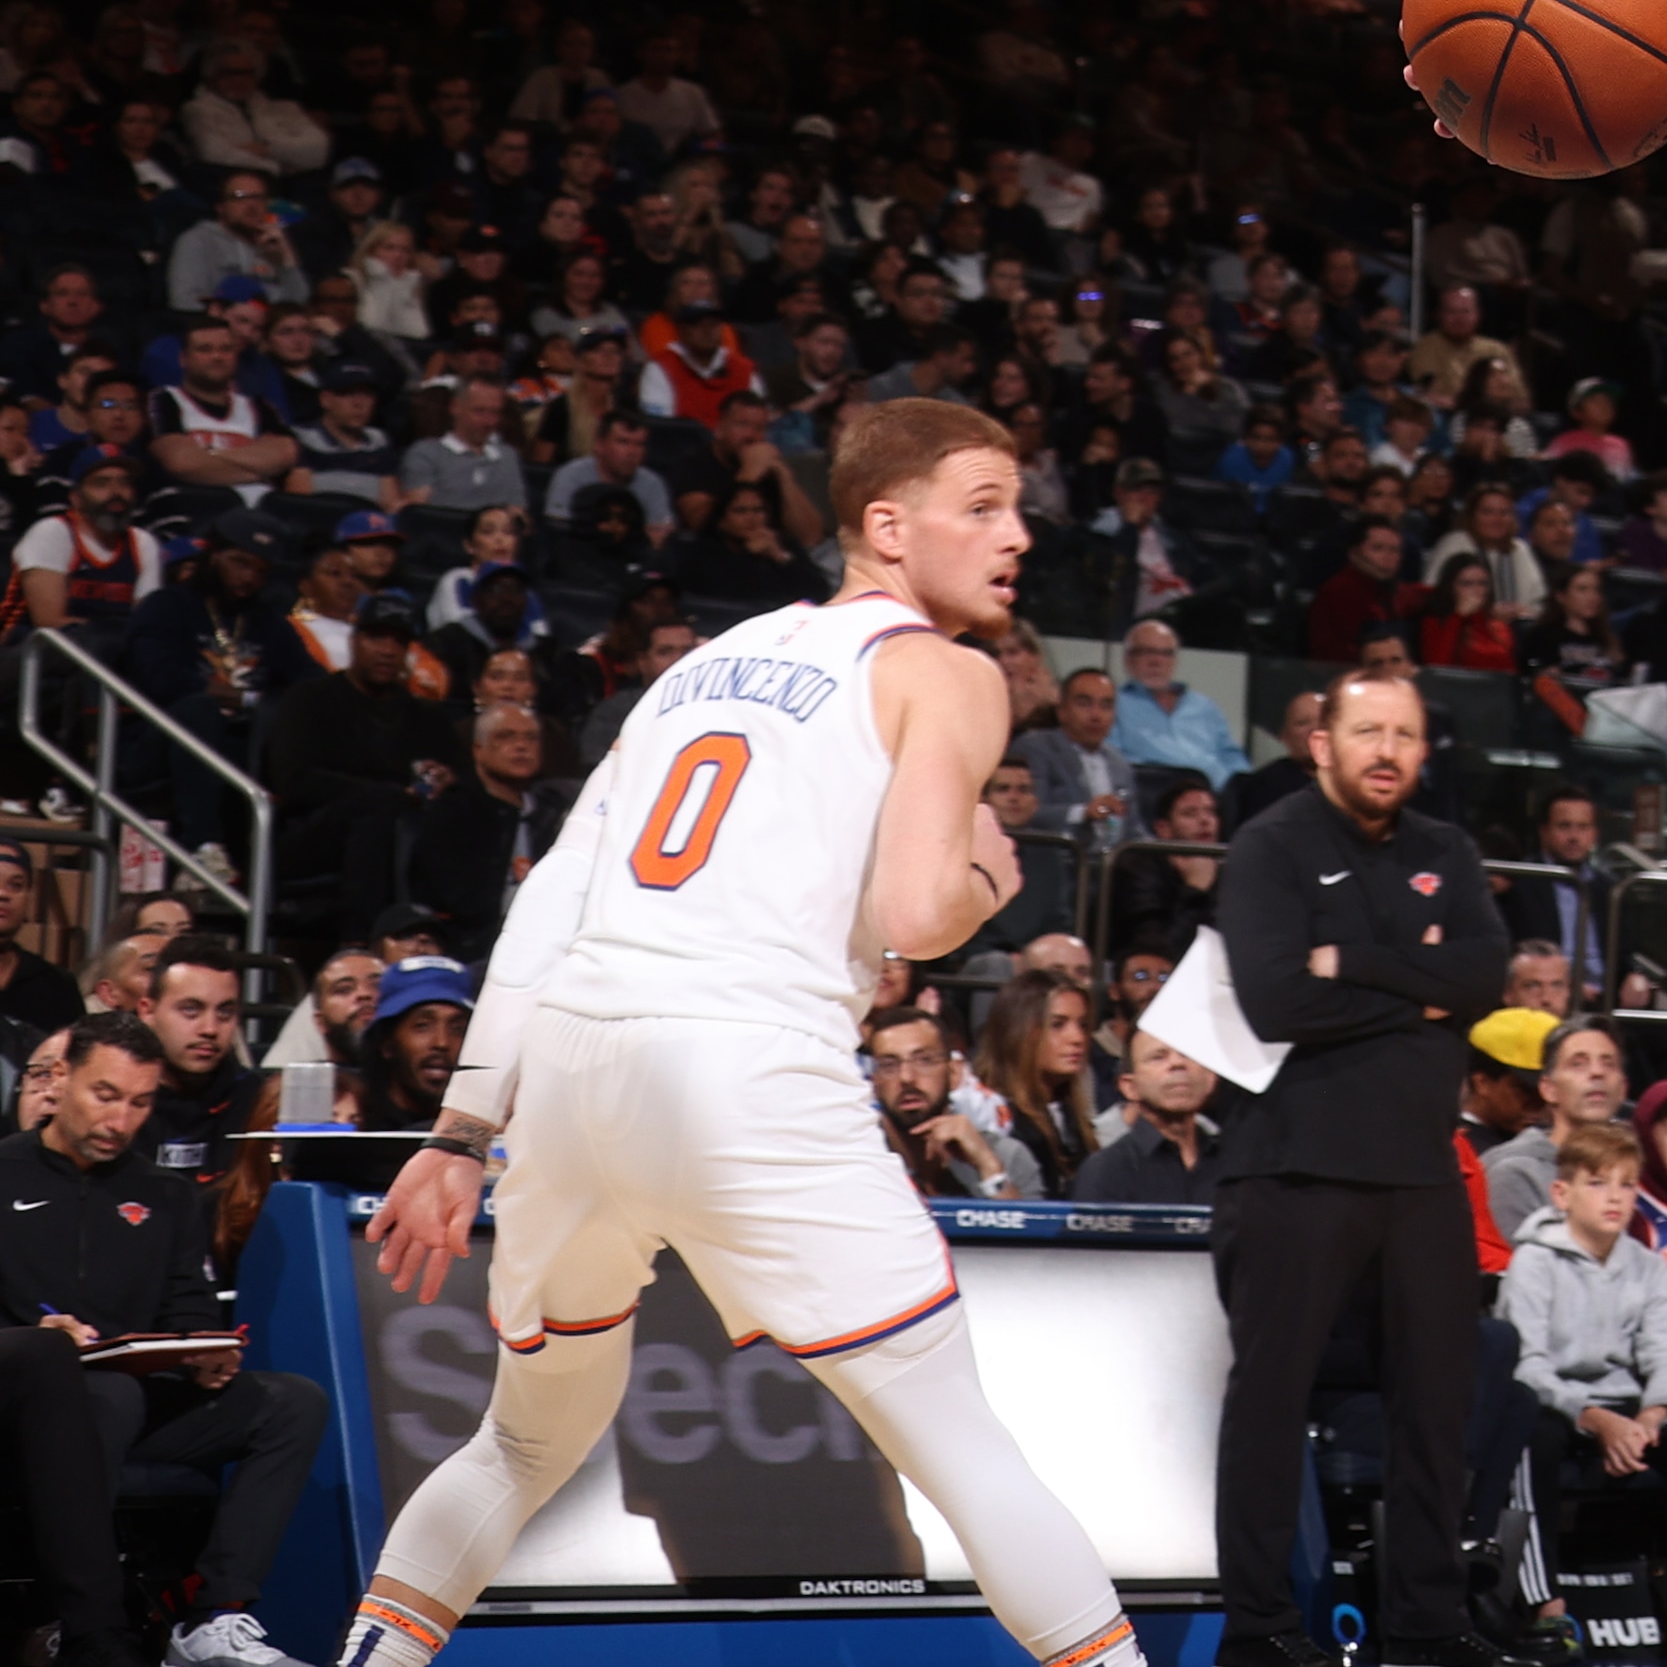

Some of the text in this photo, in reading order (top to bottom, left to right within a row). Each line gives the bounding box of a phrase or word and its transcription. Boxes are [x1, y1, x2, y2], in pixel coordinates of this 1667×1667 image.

[656, 657, 839, 724] DIVINCENZO
[629, 730, 752, 891] 0
[955, 1208, 1027, 1230] CHASE
[1065, 1212, 1135, 1233] CHASE
[799, 1579, 927, 1596] DAKTRONICS
[1585, 1616, 1662, 1648] HUB
